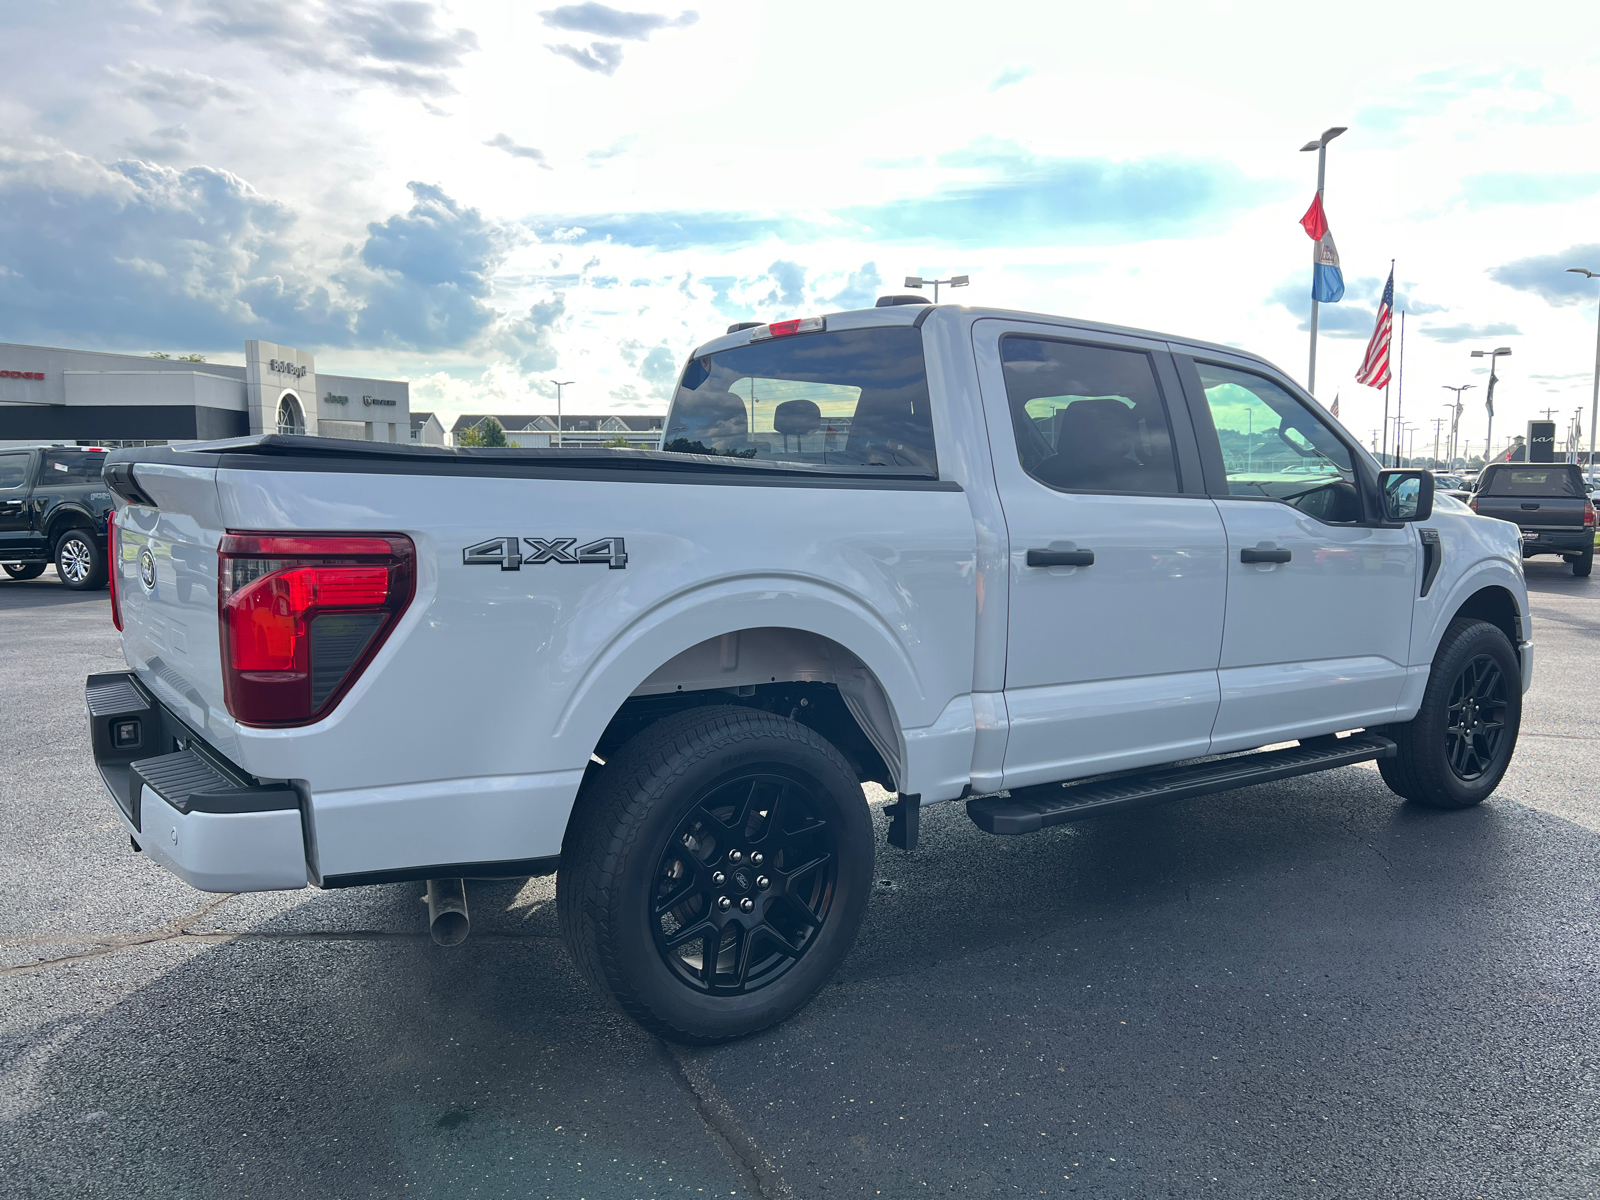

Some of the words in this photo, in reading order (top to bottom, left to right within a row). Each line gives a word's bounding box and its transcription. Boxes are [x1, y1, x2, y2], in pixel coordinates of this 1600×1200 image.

[270, 359, 288, 373] Bob
[0, 370, 45, 380] ODGE
[324, 392, 349, 406] Jeep
